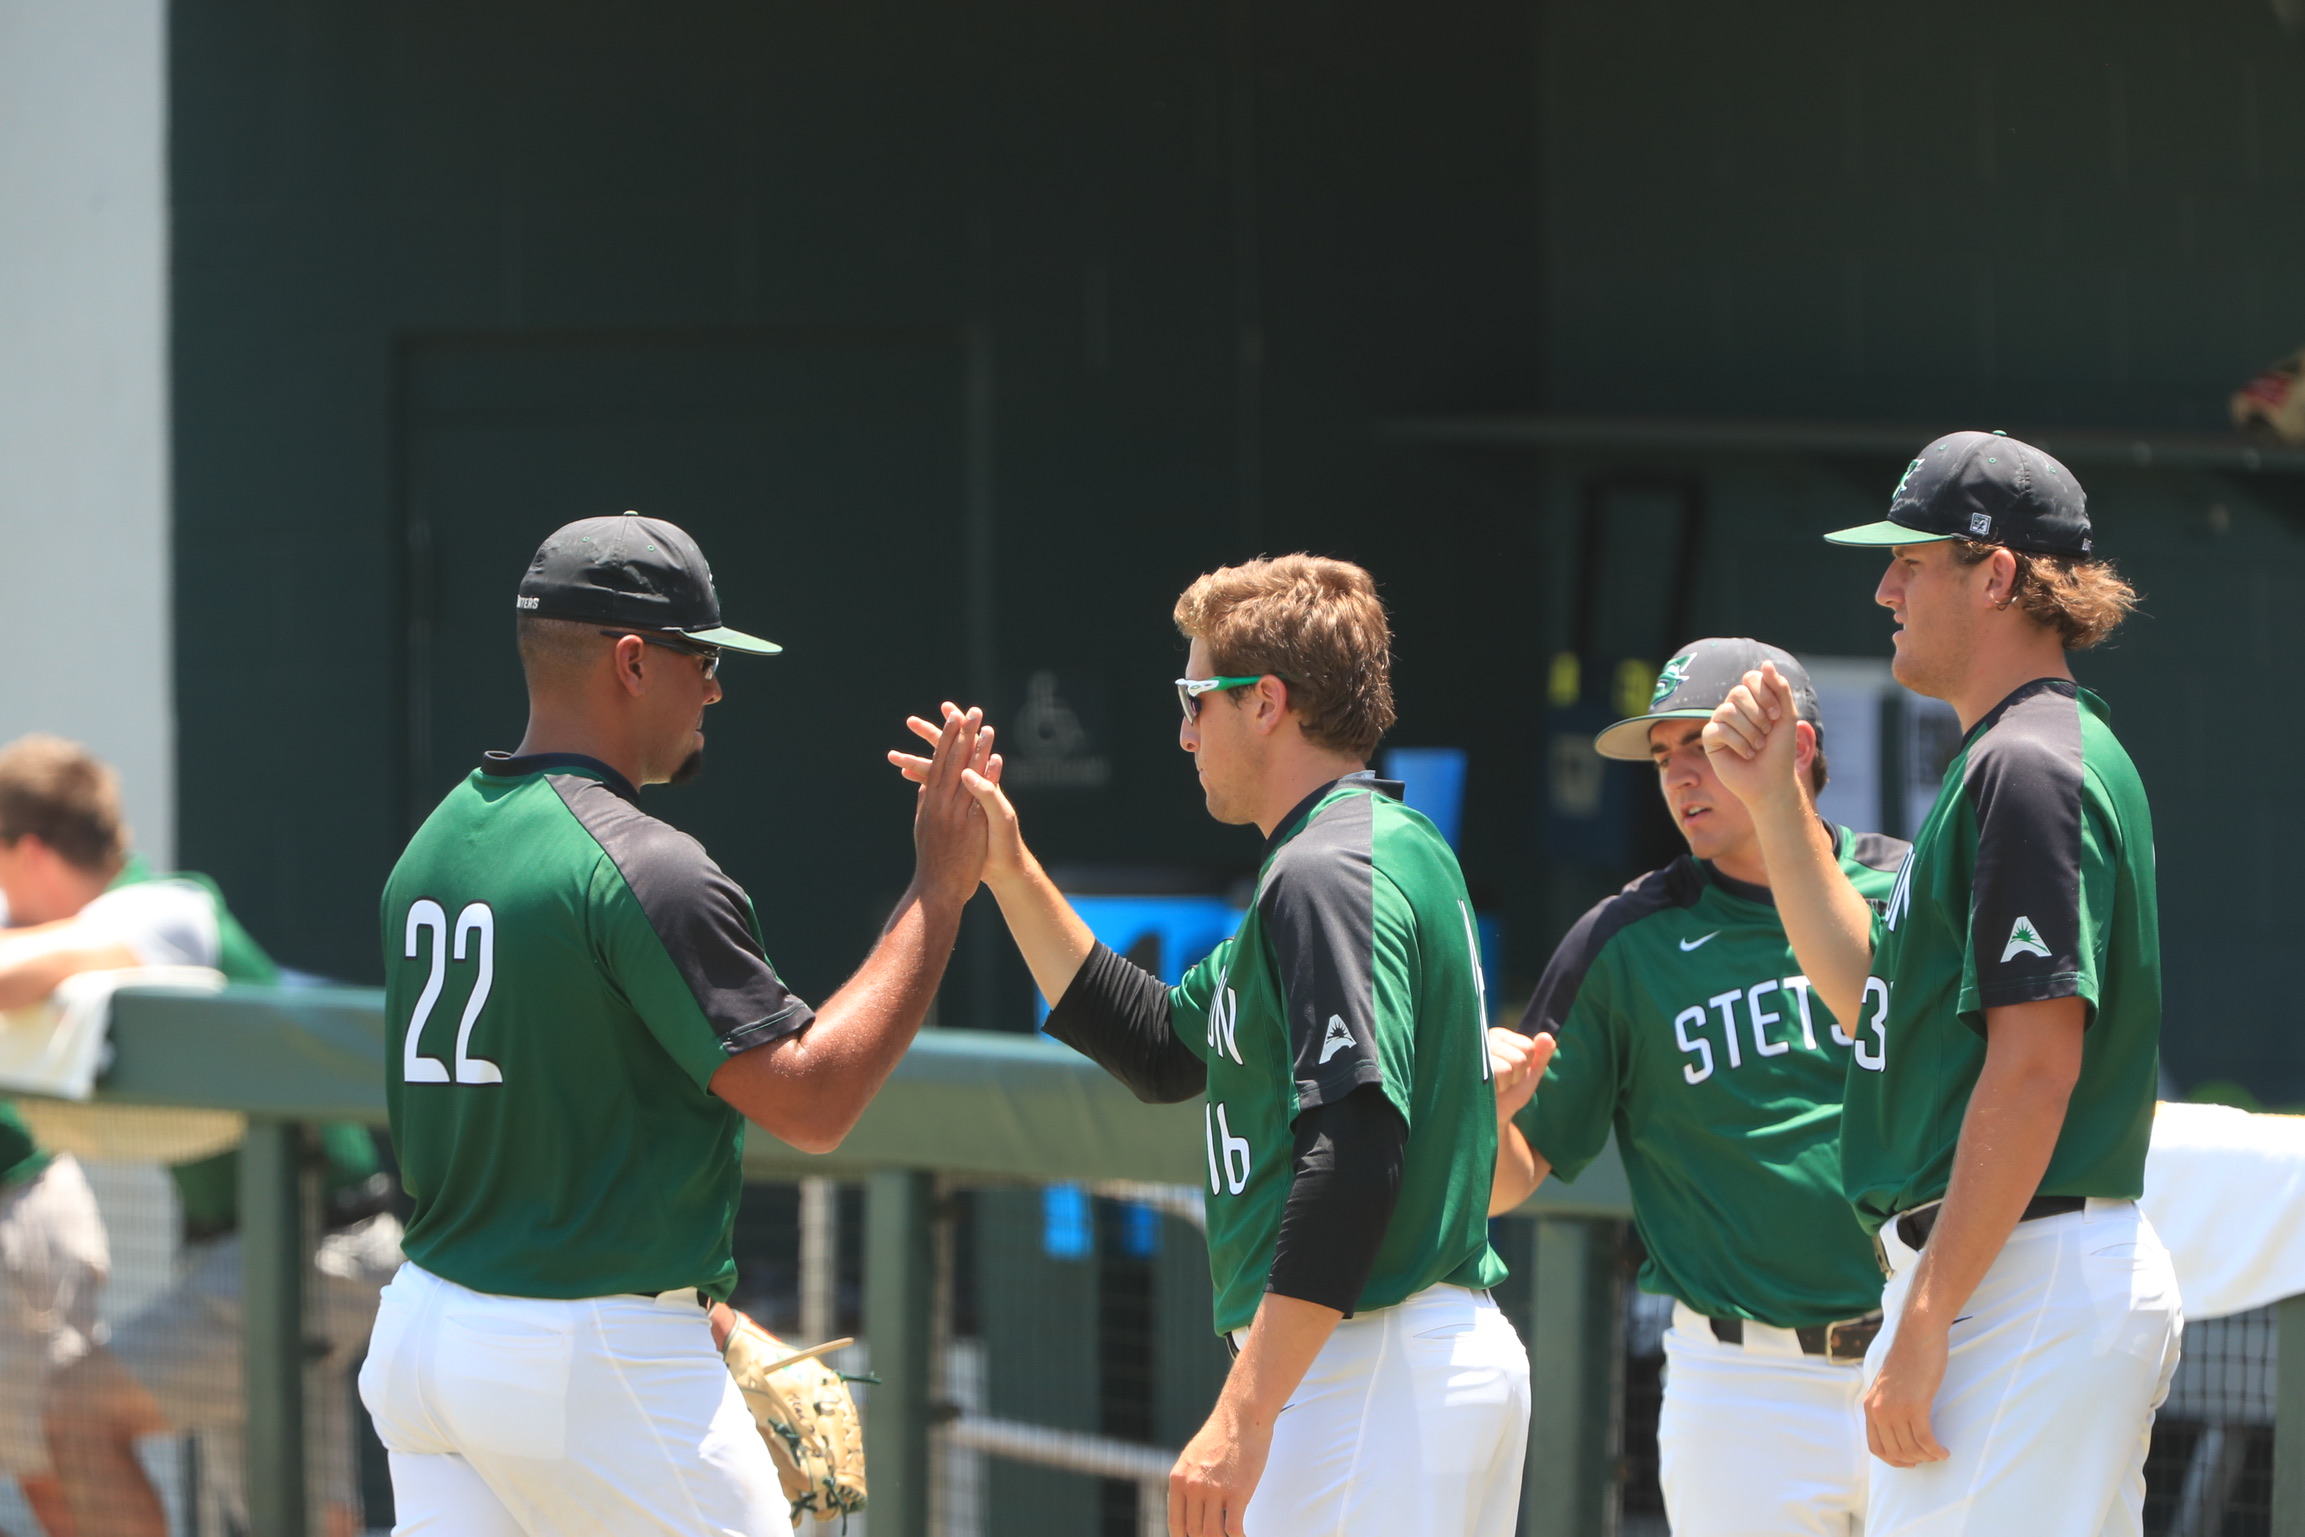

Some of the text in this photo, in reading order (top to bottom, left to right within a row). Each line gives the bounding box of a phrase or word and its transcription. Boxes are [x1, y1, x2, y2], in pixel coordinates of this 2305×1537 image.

[402, 897, 504, 1085] 22
[1674, 974, 1854, 1086] STET
[1205, 1101, 1251, 1196] 16
